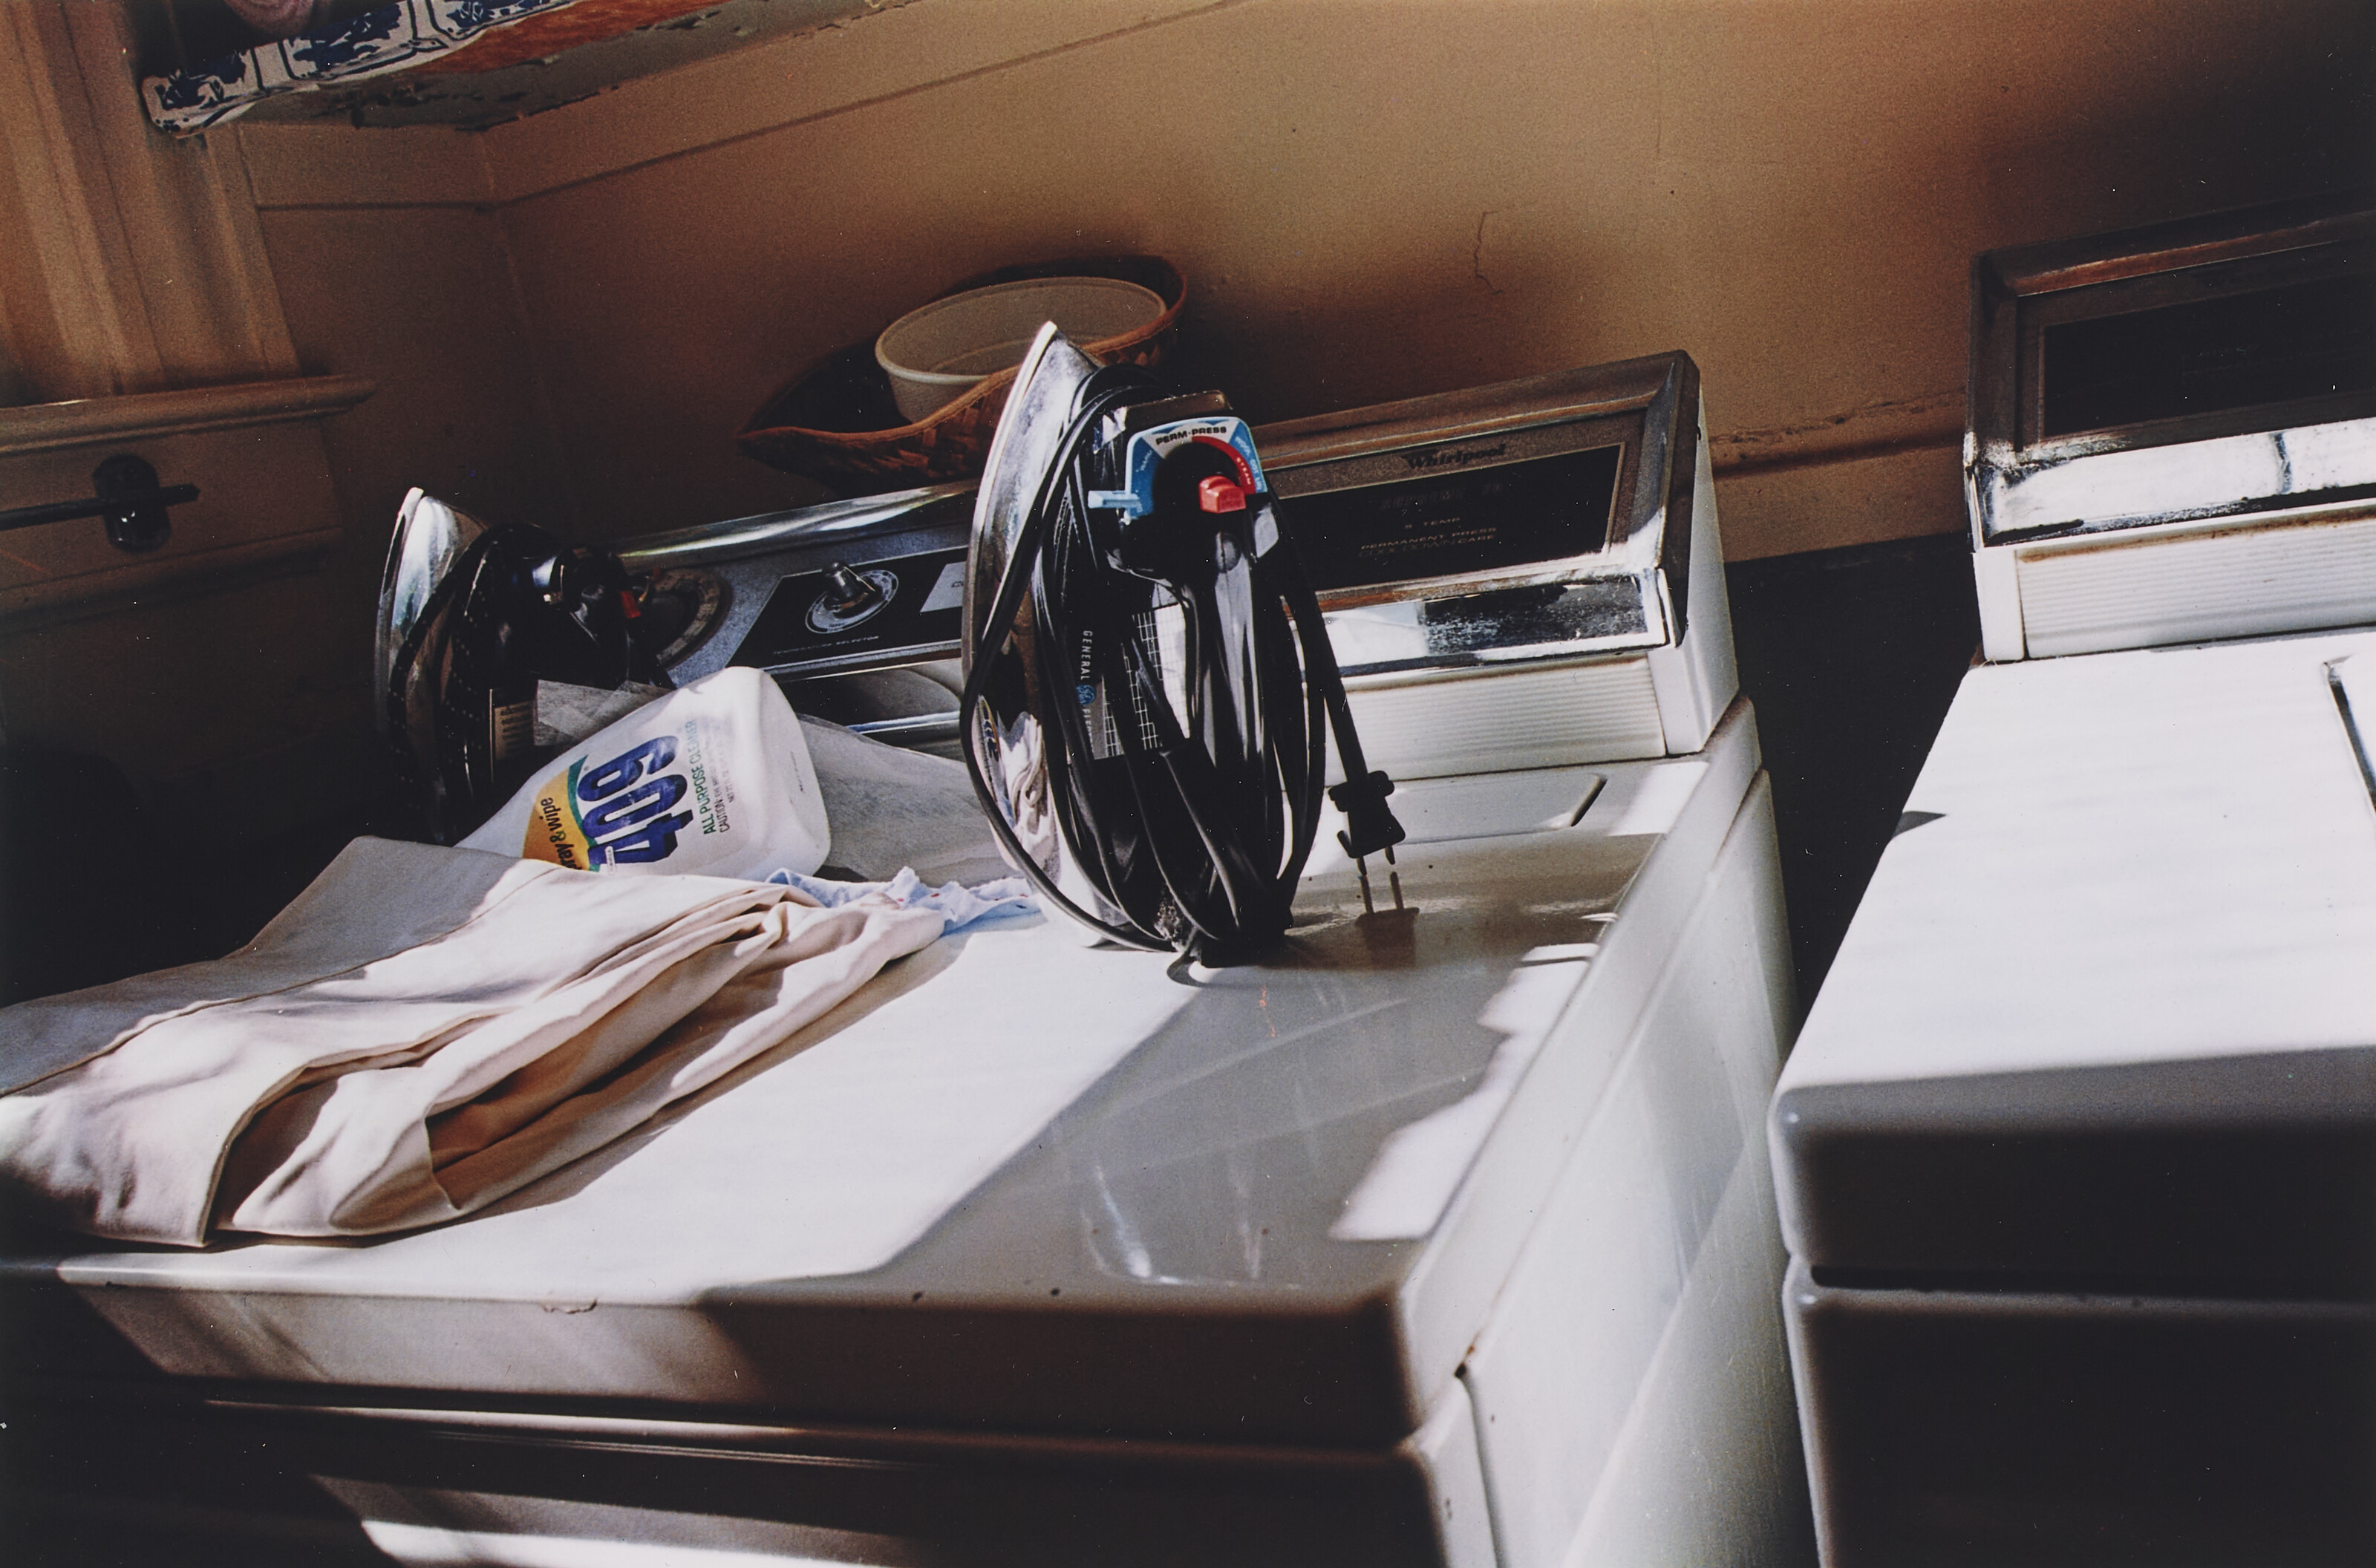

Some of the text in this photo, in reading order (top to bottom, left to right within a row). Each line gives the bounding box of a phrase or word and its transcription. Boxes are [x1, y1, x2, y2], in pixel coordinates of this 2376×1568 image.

[1236, 457, 1252, 485] STEAM
[1400, 442, 1506, 469] Whirlpool
[1361, 527, 1498, 550] PERMANENT PRESS
[1080, 630, 1093, 681] GENERAL
[577, 735, 693, 865] 409
[685, 719, 717, 835] ALL PURPOSE CLEANER
[539, 797, 582, 870] pray & wipe
